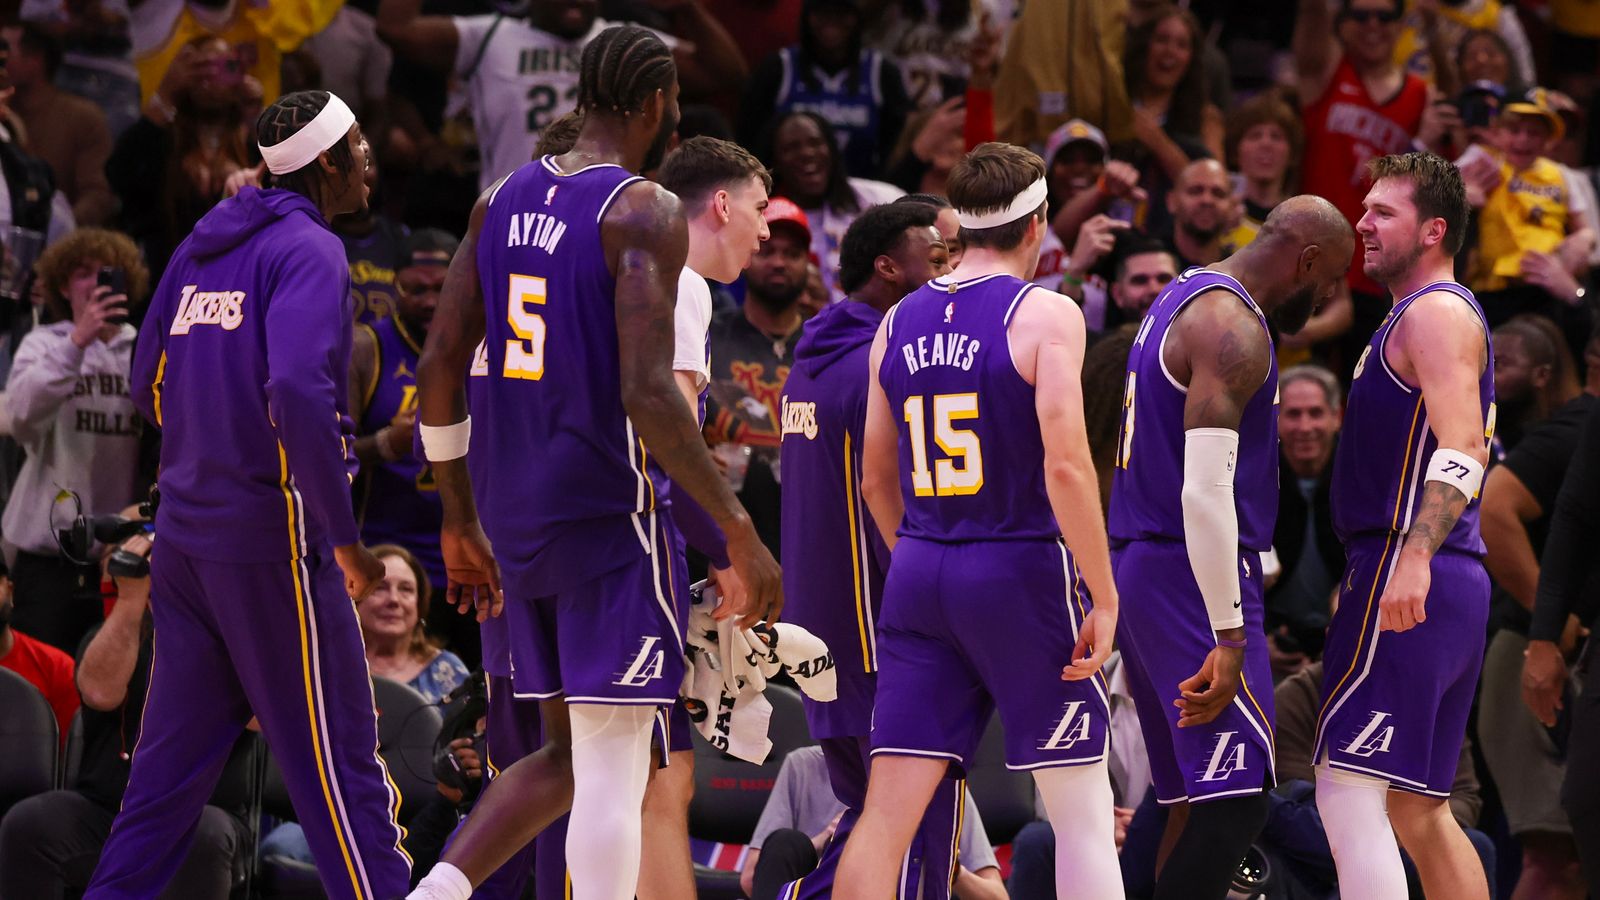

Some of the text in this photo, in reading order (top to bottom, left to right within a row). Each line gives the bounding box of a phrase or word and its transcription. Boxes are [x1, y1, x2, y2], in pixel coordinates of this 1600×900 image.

[526, 84, 580, 132] 2
[507, 212, 568, 256] AYTON
[169, 284, 247, 336] LAKERS
[502, 273, 547, 381] 5
[902, 332, 981, 376] REAVES
[903, 392, 985, 497] 15
[1440, 460, 1471, 481] 77
